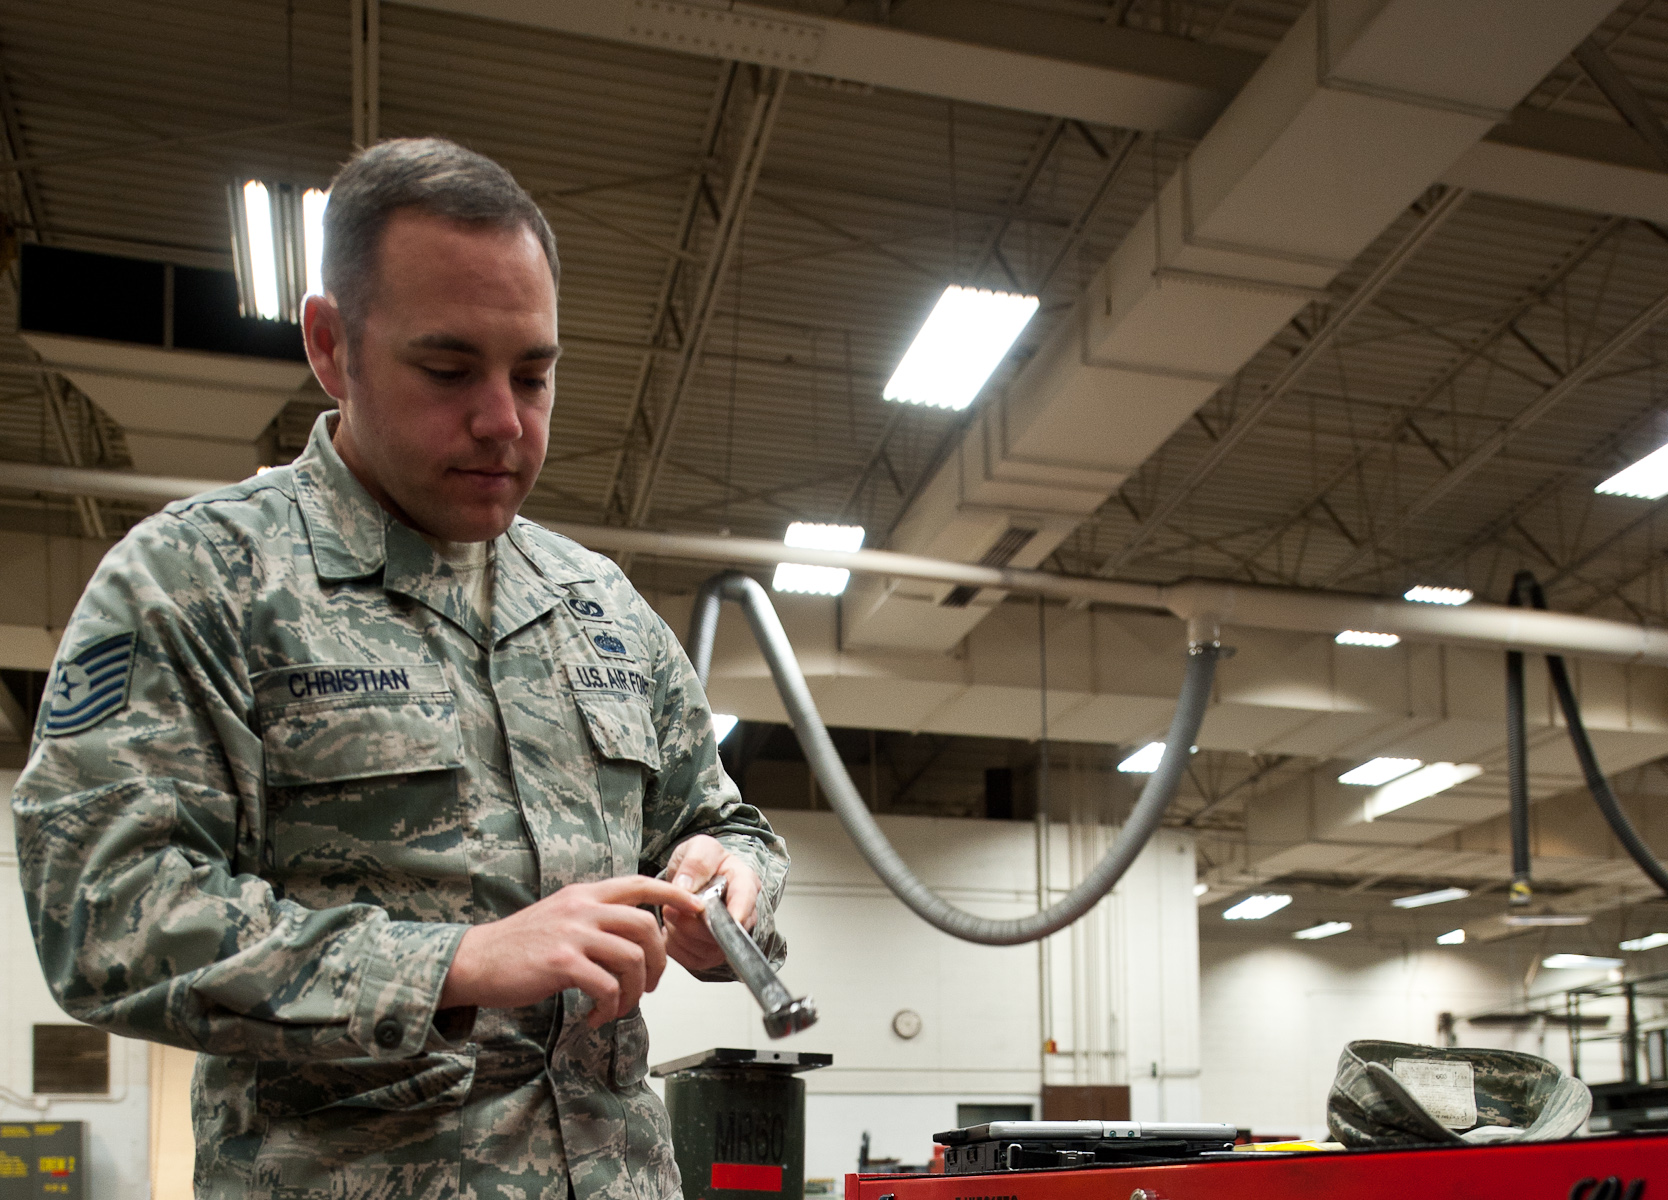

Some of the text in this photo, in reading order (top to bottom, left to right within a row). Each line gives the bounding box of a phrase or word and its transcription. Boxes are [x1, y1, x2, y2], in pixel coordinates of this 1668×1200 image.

[288, 668, 410, 698] CHRISTIAN
[576, 666, 608, 689] U.S.
[606, 668, 632, 692] AIR
